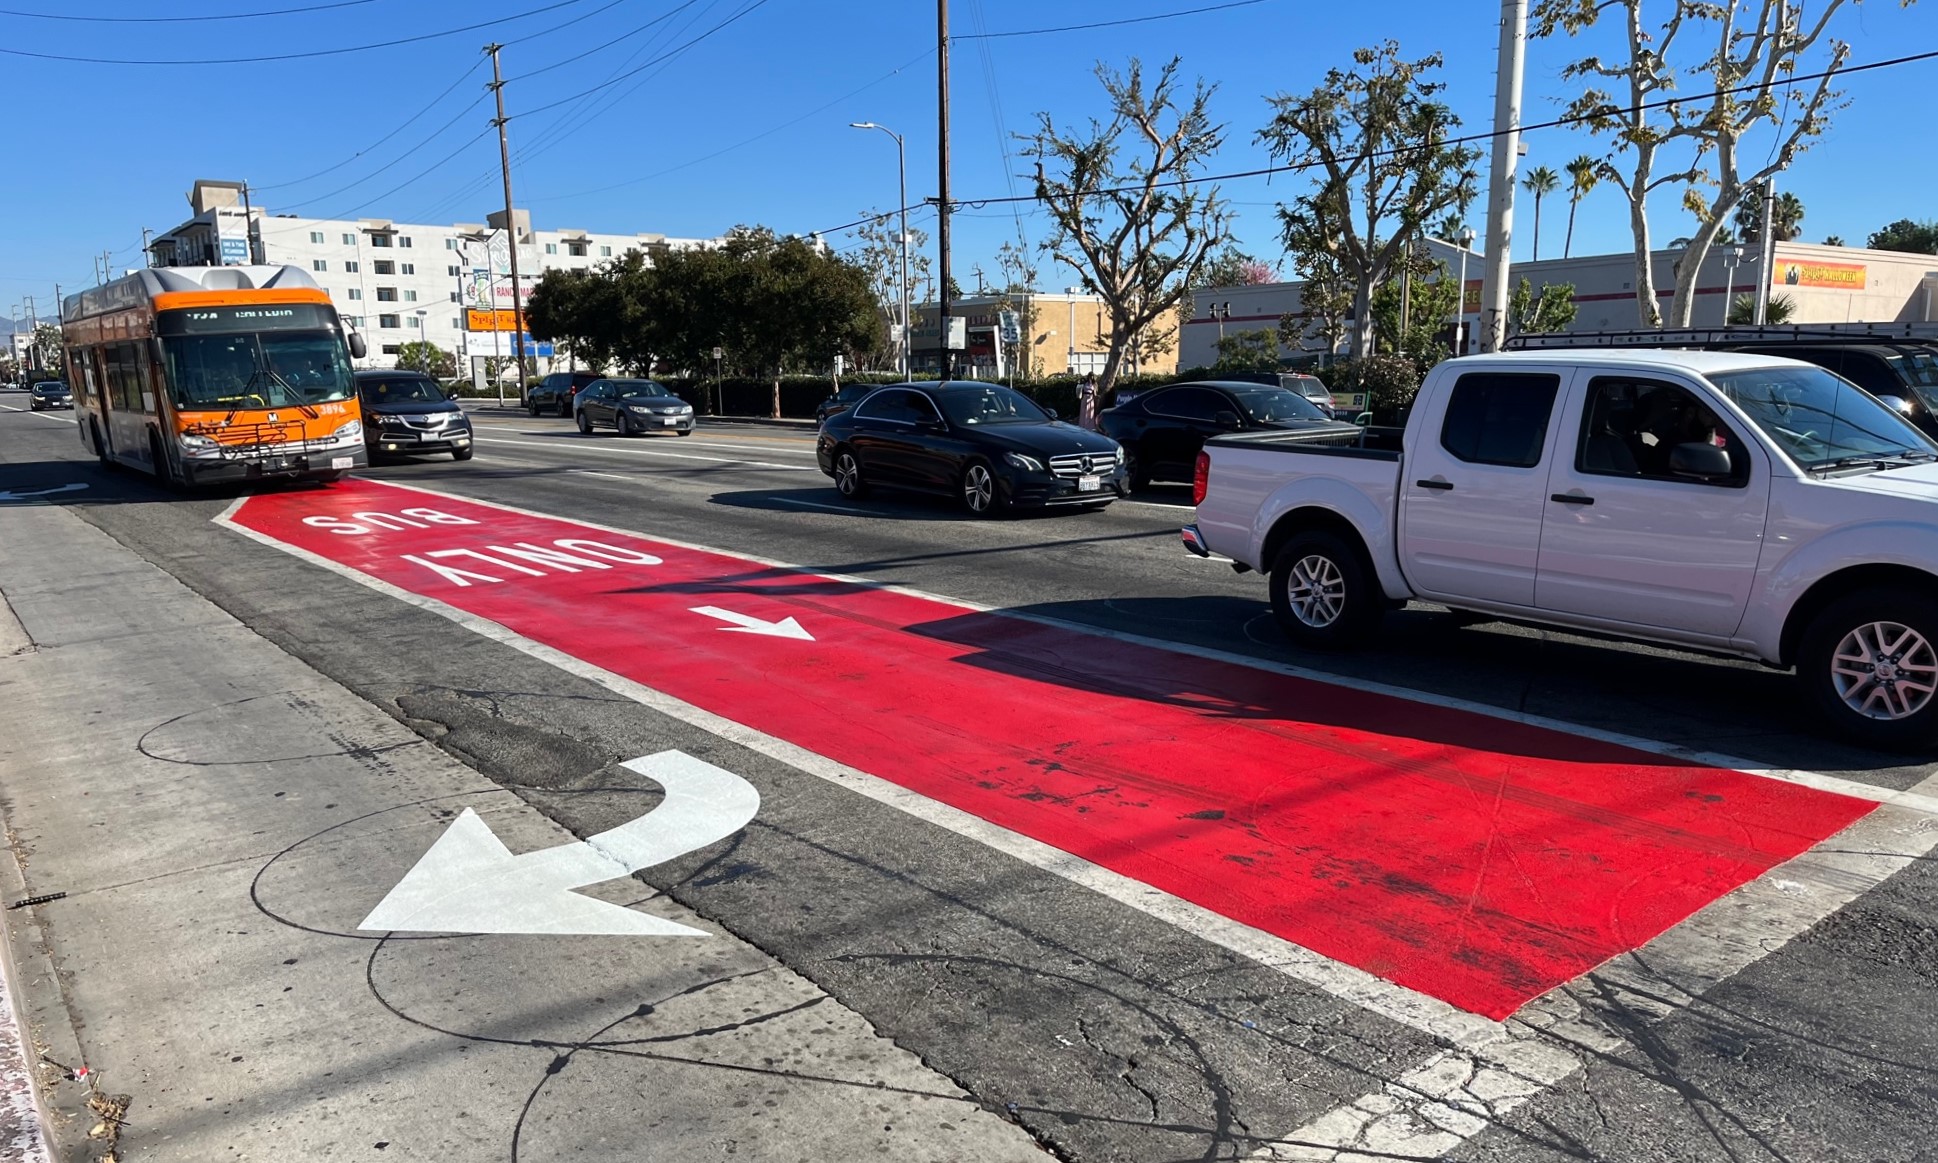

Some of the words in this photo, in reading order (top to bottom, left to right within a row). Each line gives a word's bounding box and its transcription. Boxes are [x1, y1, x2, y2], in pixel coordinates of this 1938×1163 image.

[1003, 327, 1018, 341] 35
[320, 404, 346, 415] 3896
[302, 507, 482, 535] BUS
[399, 538, 664, 587] ONLY
